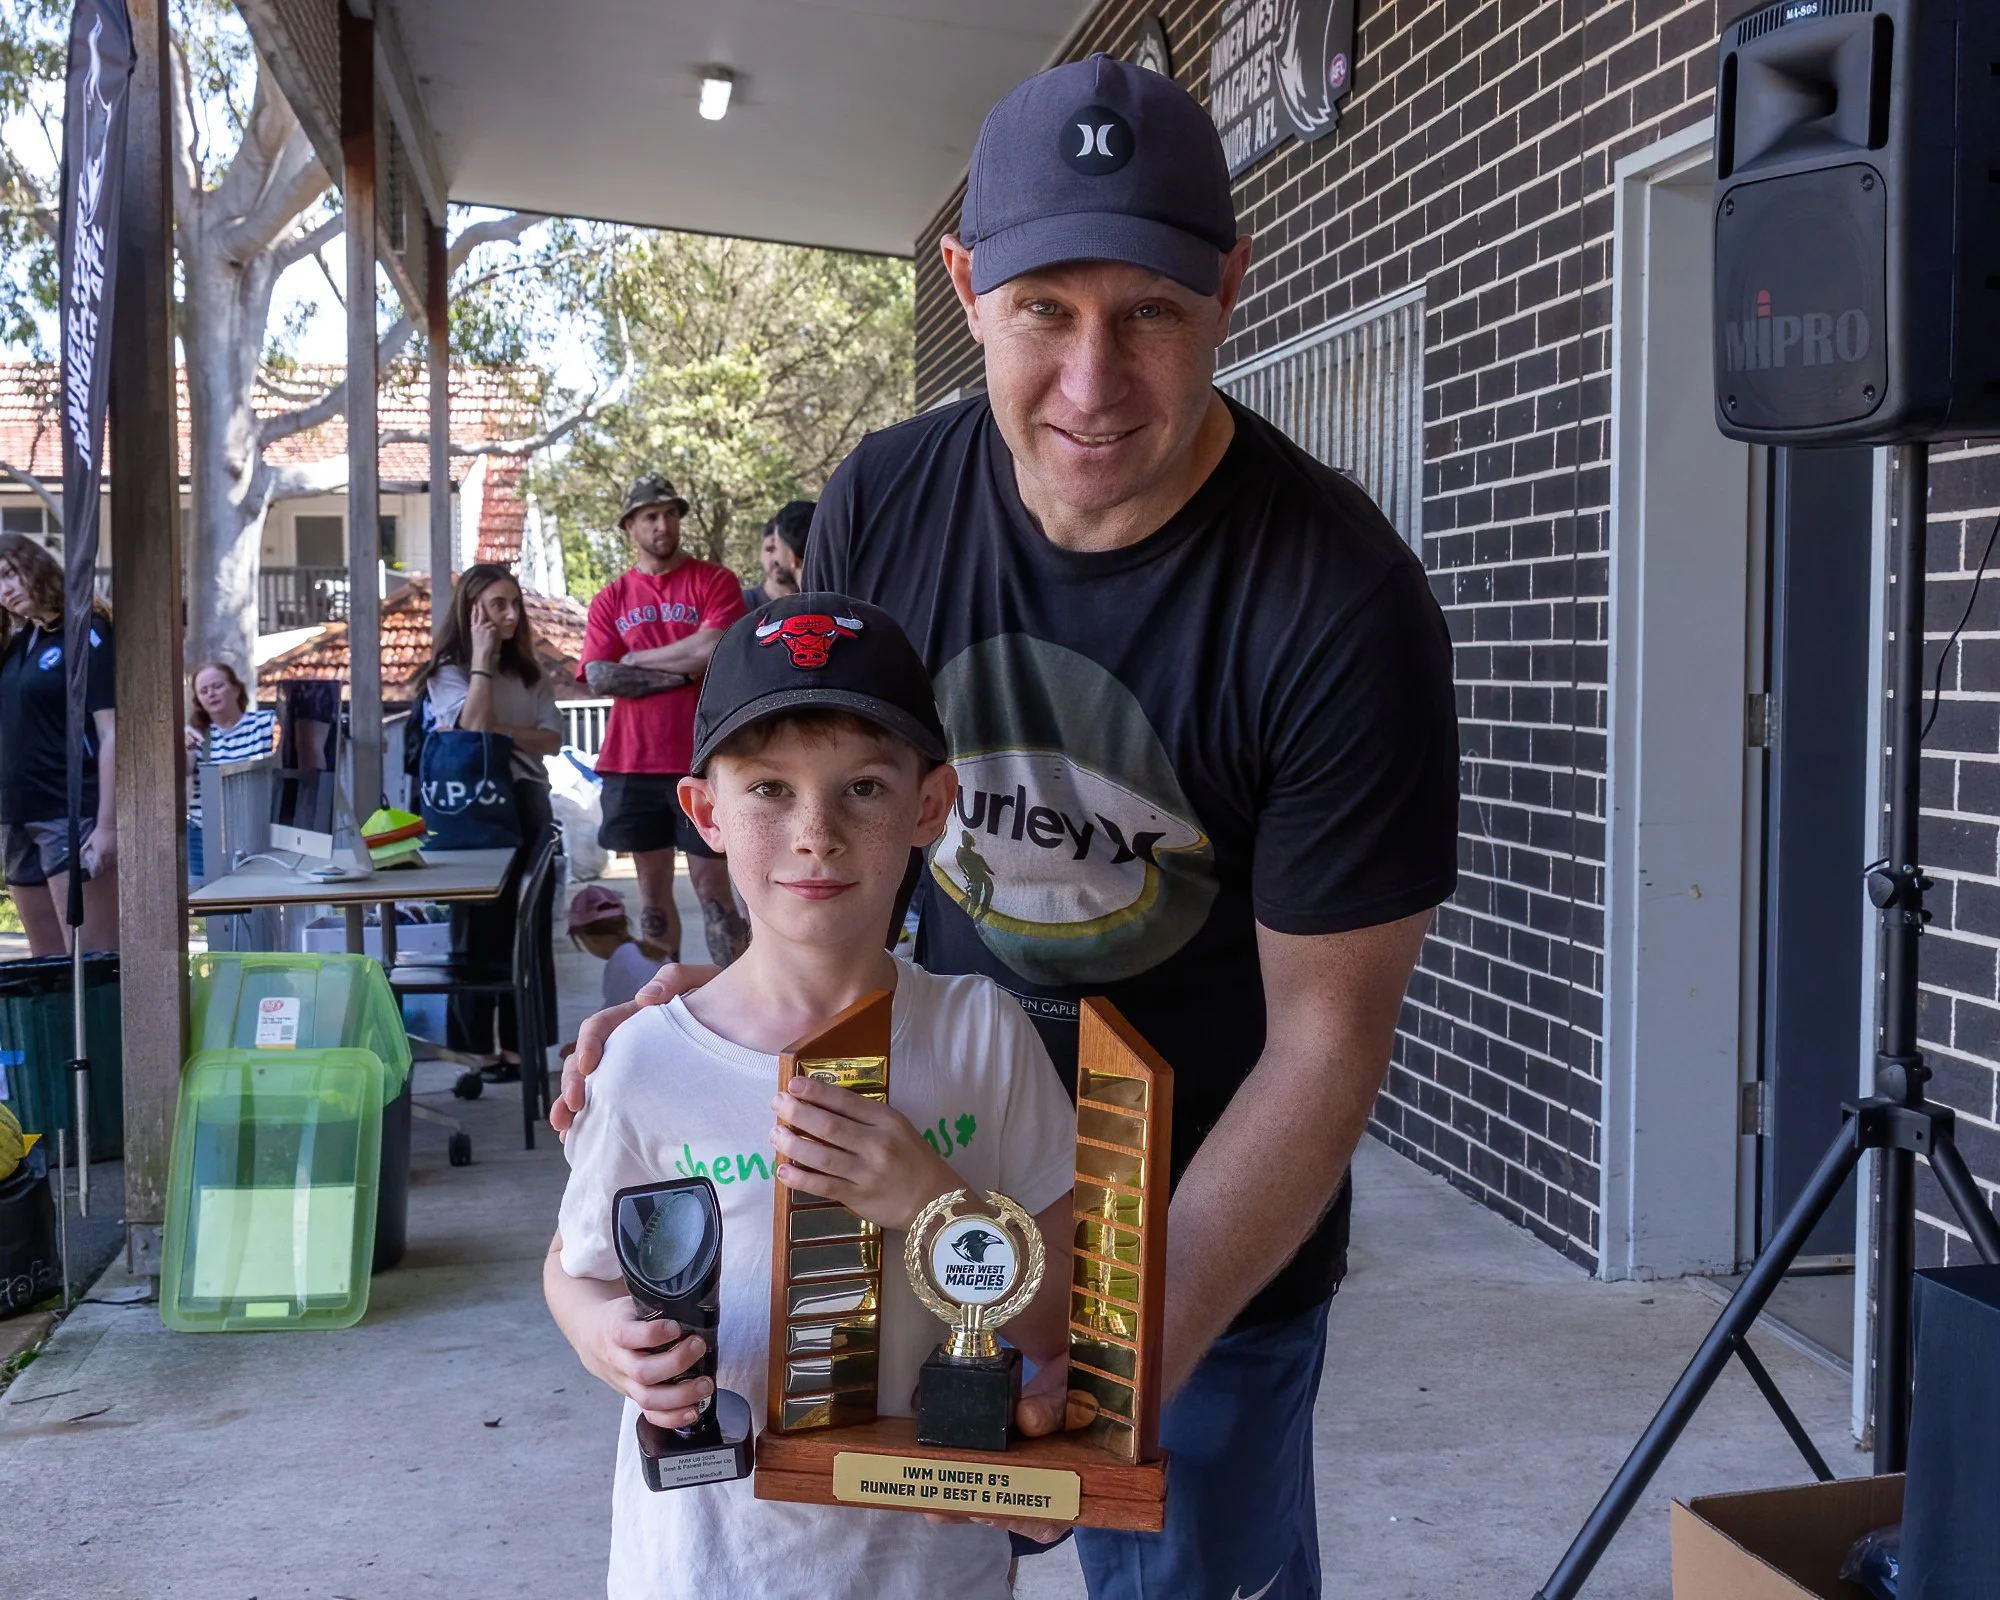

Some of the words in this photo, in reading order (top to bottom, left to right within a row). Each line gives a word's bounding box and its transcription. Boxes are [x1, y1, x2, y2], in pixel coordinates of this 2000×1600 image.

[1210, 17, 1245, 88] INNER
[1210, 40, 1272, 131] MAGPIES
[1219, 116, 1251, 171] NIOR
[1254, 96, 1278, 151] AFL
[954, 784, 1094, 860] urley
[1015, 997, 1037, 1010] EN
[1041, 1002, 1080, 1016] CAPLE
[945, 1274, 1005, 1286] MAGPIES
[946, 1265, 975, 1273] INNER
[977, 1265, 1005, 1274] WEST
[903, 1466, 933, 1481] IWM
[938, 1469, 983, 1485] UNDER
[988, 1474, 1010, 1487] 8'S
[860, 1480, 915, 1497] RUNNER
[920, 1485, 938, 1498] UP
[943, 1487, 977, 1502] BEST
[981, 1491, 991, 1503] &
[996, 1491, 1051, 1508] FAIREST
